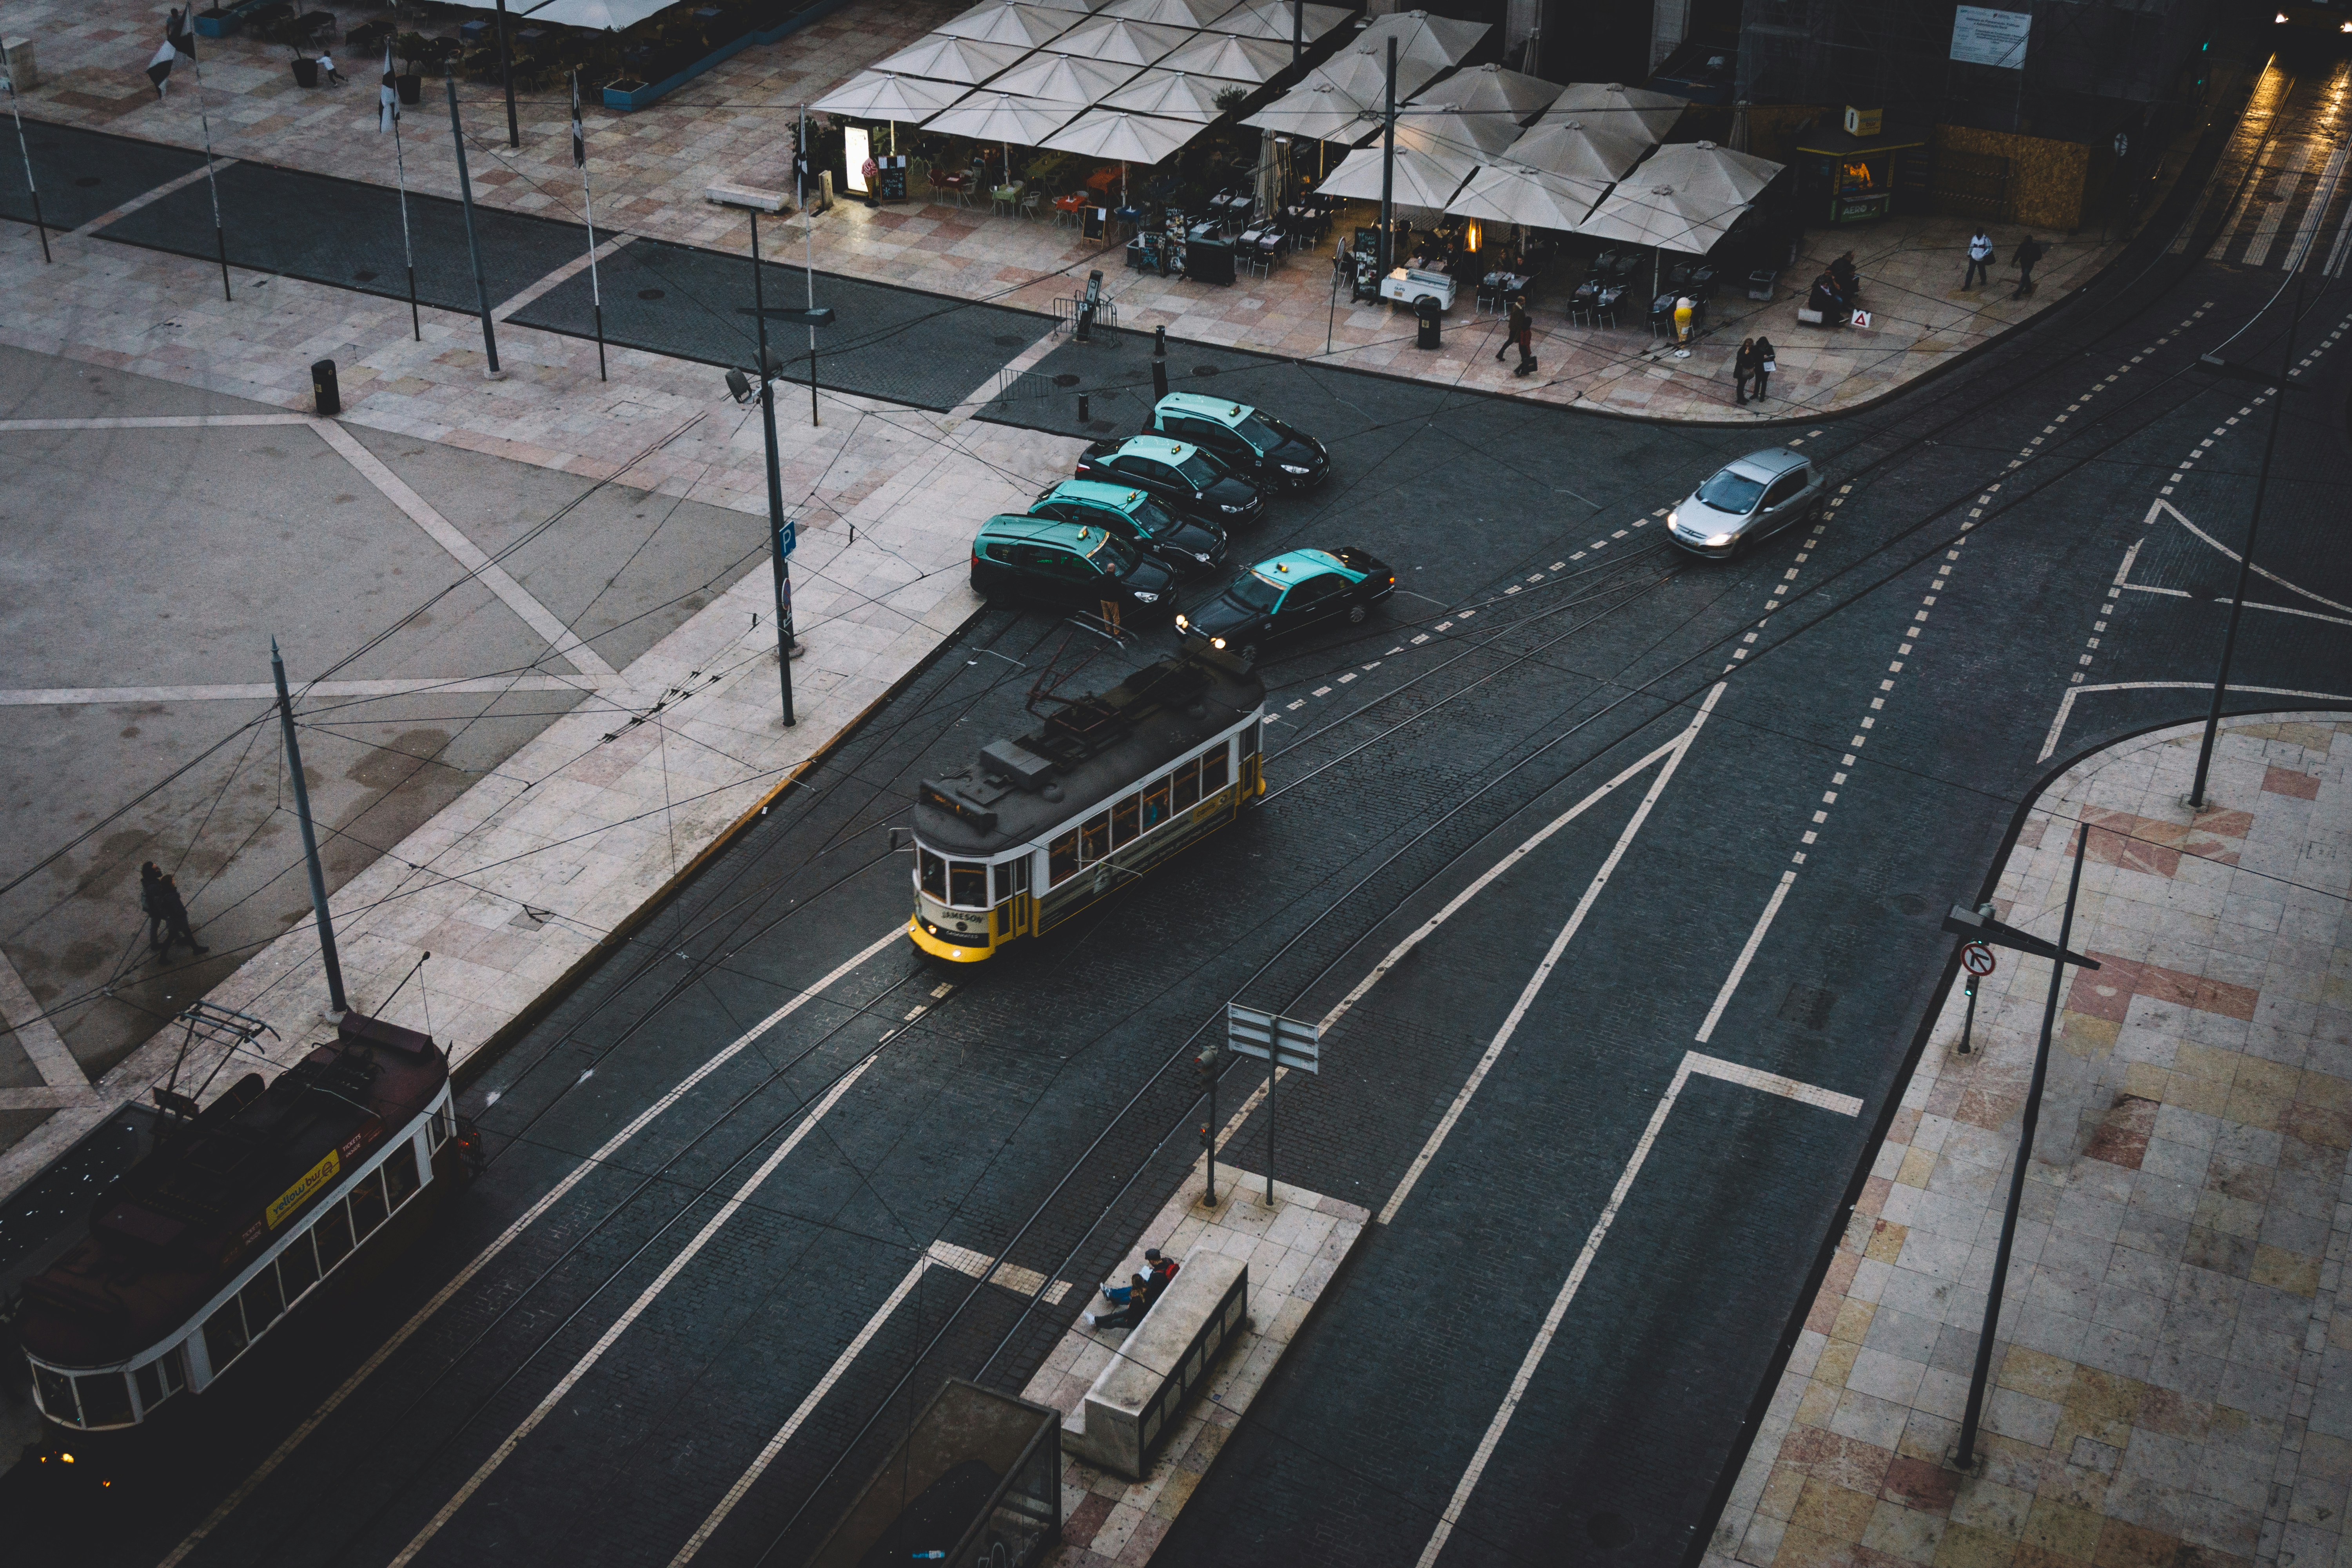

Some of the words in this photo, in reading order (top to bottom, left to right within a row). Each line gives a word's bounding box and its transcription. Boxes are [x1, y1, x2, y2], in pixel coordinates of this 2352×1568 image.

[782, 529, 791, 552] P
[942, 911, 984, 923] JAMESON
[343, 1133, 361, 1152] TICKETS
[305, 1170, 321, 1187] bus
